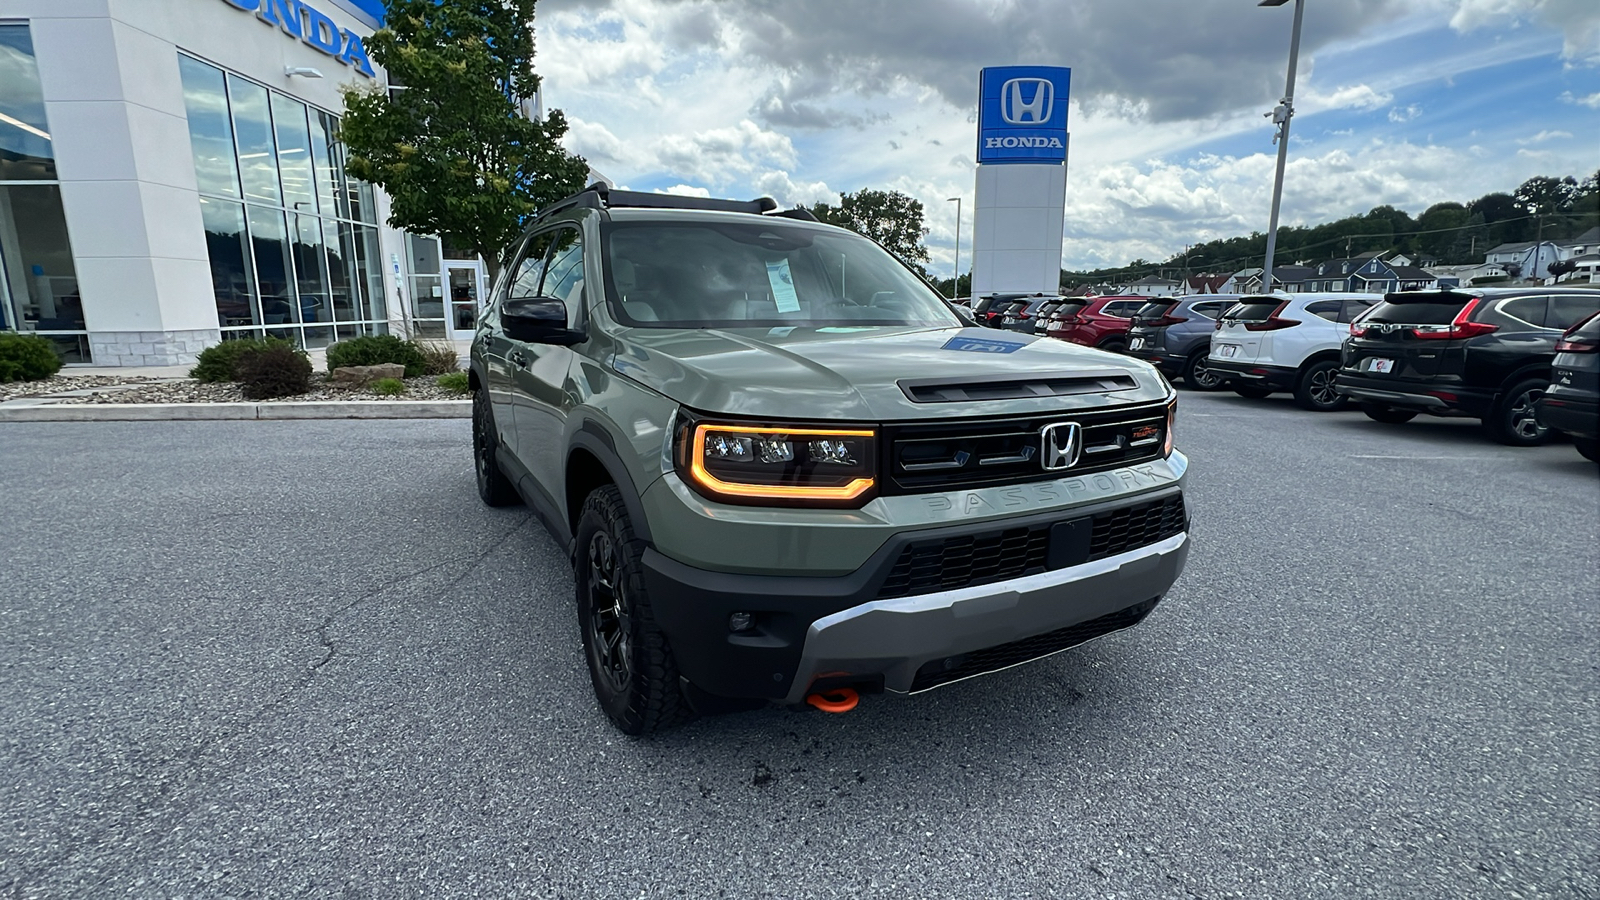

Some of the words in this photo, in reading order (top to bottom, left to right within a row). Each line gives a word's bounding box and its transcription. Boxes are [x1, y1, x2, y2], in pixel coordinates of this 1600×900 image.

[222, 0, 376, 78] NDA
[985, 137, 1063, 148] HONDA
[920, 465, 1173, 519] PASSPORT
